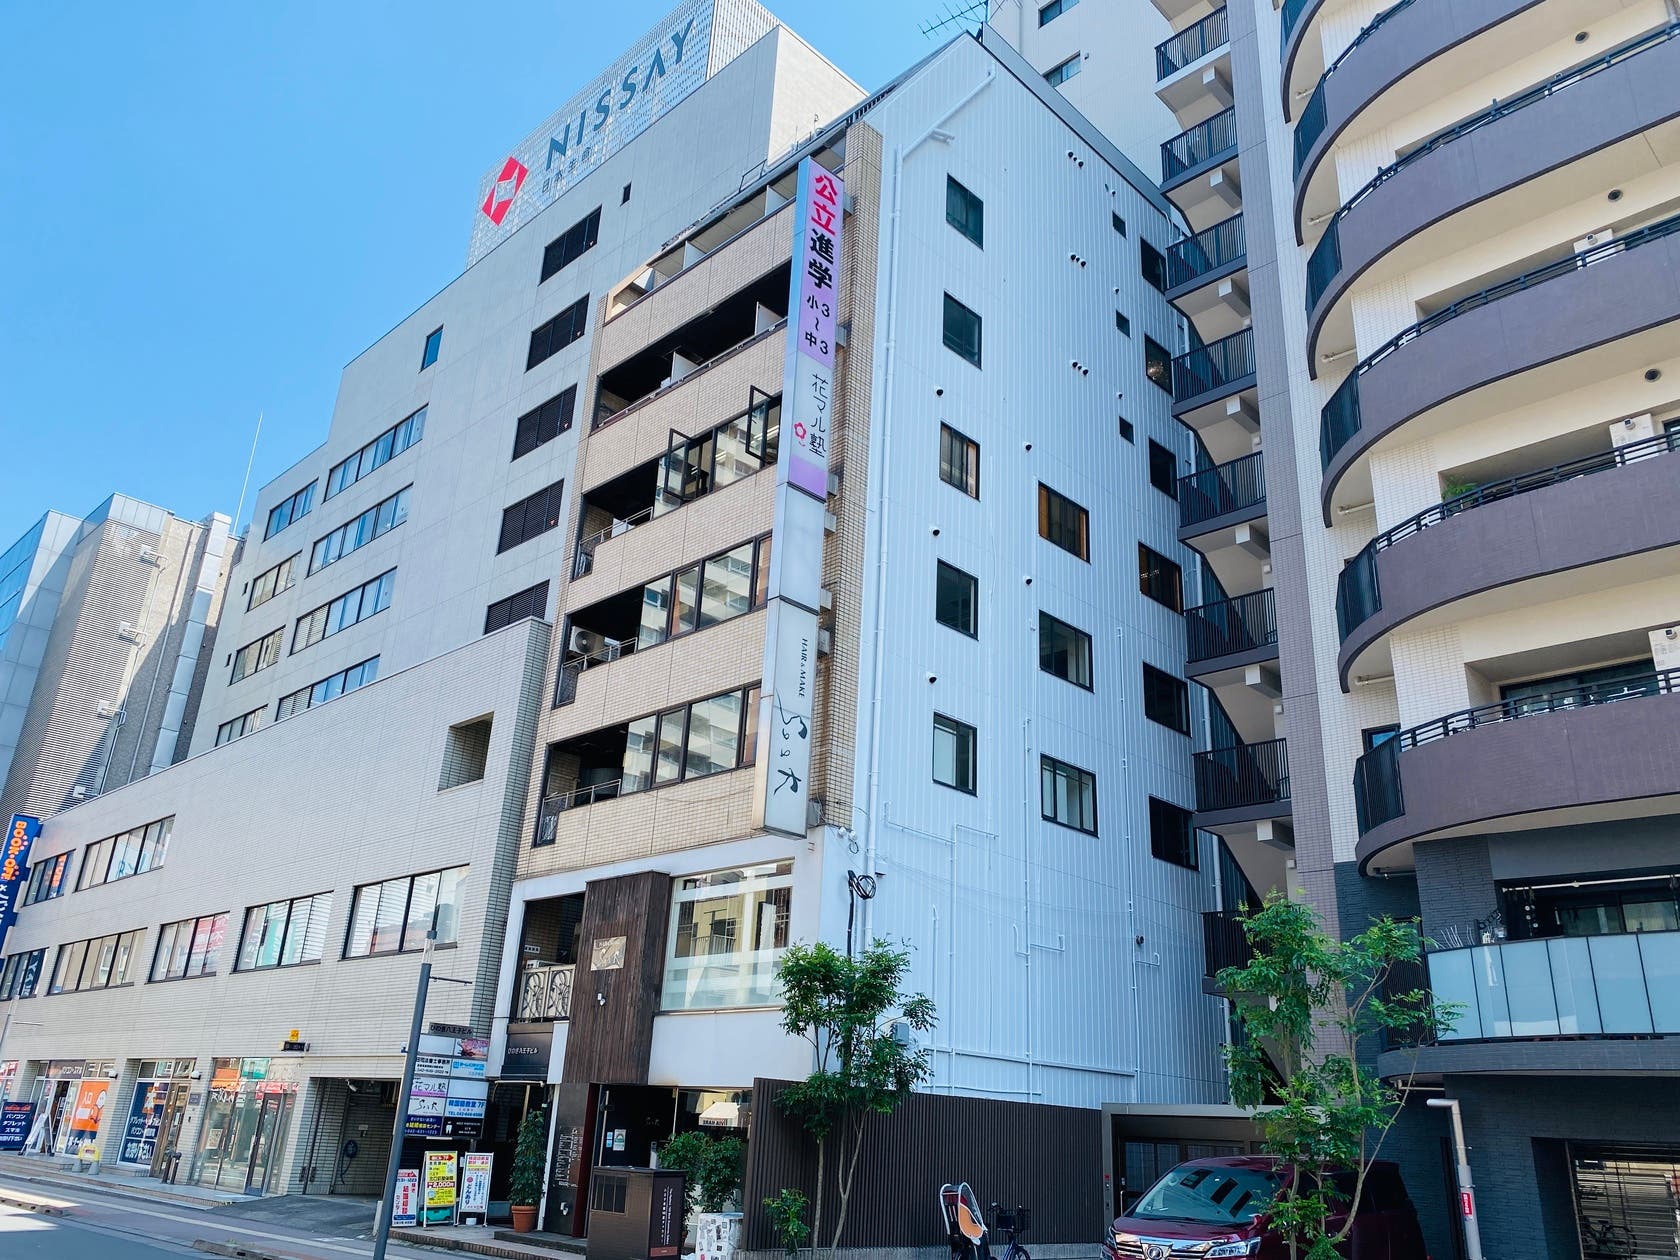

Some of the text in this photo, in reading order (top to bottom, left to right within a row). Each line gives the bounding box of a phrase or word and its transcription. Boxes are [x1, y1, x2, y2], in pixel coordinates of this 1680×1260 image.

[545, 17, 695, 170] NISSAY
[807, 173, 839, 290] 公立進学
[809, 372, 829, 459] 花マル塾
